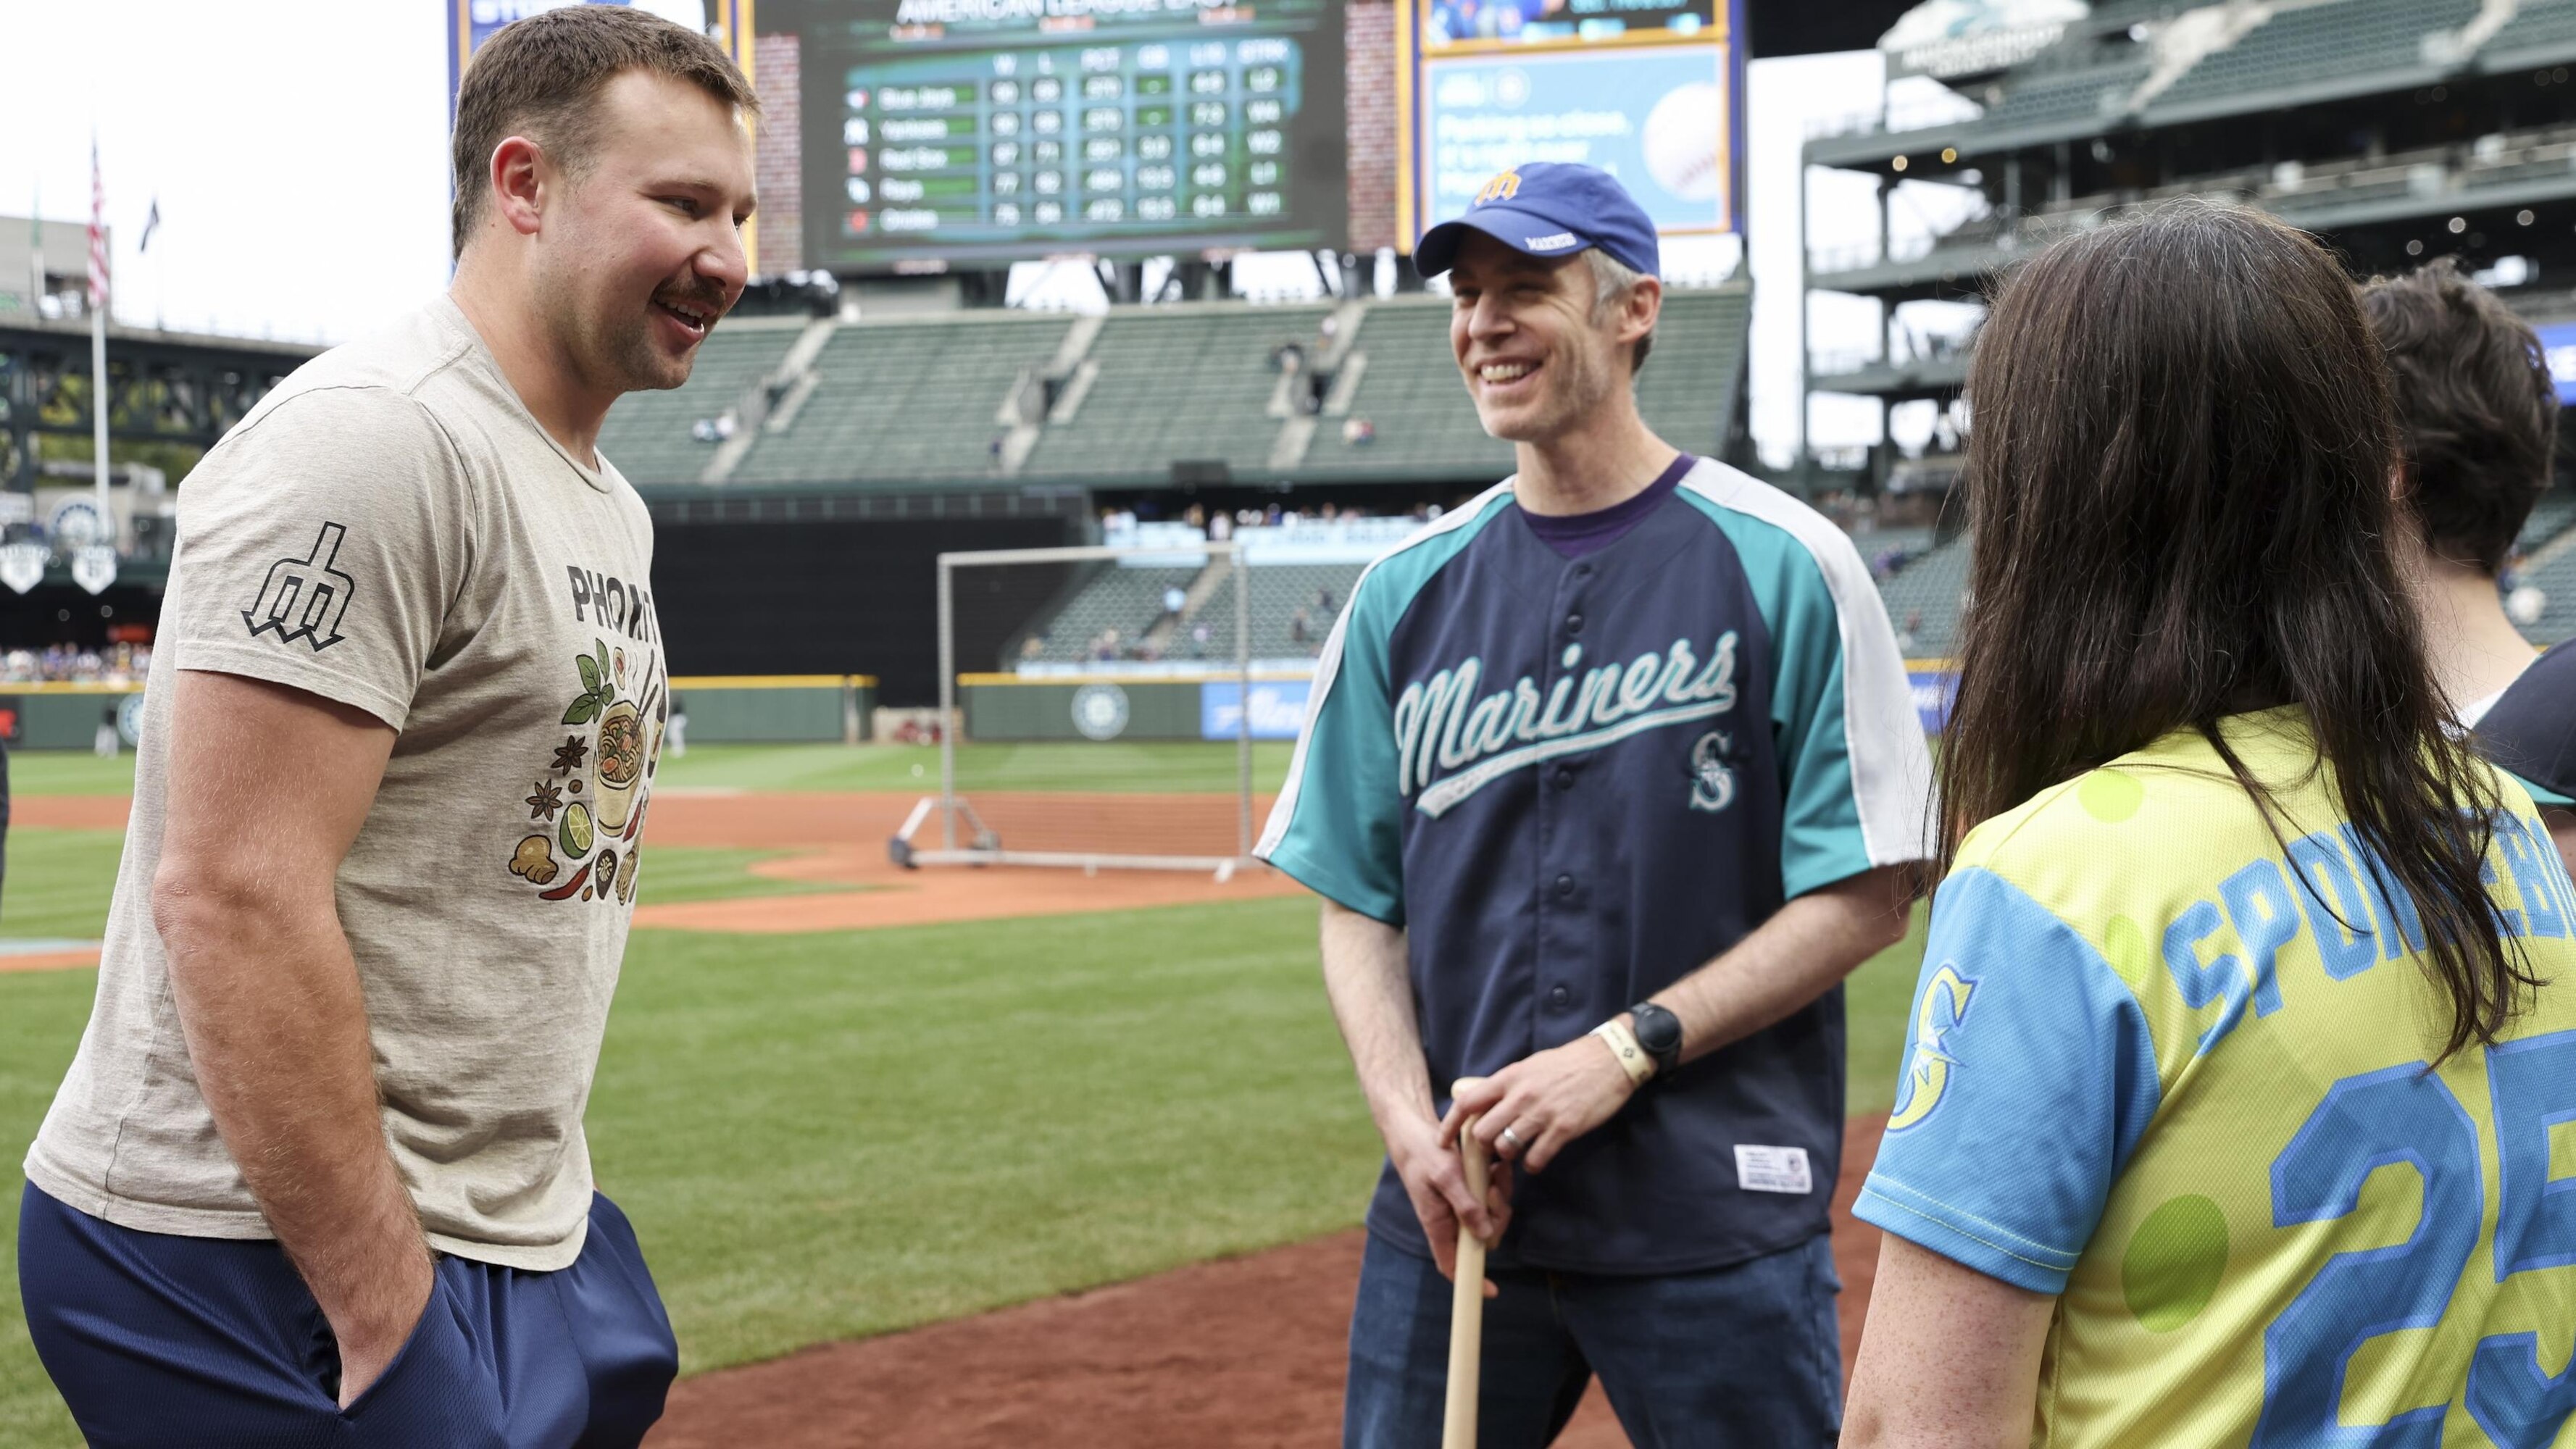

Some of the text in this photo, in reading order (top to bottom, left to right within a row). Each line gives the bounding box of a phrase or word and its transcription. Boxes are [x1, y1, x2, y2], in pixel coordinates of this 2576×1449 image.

[896, 0, 1042, 24] AMERICAN
[993, 53, 1017, 76] W
[878, 87, 917, 111] Blue
[918, 86, 956, 110] Jays
[879, 119, 948, 141] Yankees
[879, 148, 914, 171] Red
[914, 146, 948, 170] Sox
[879, 178, 923, 203] Rays
[879, 207, 939, 232] Orioles
[1395, 630, 1738, 797] Mariners
